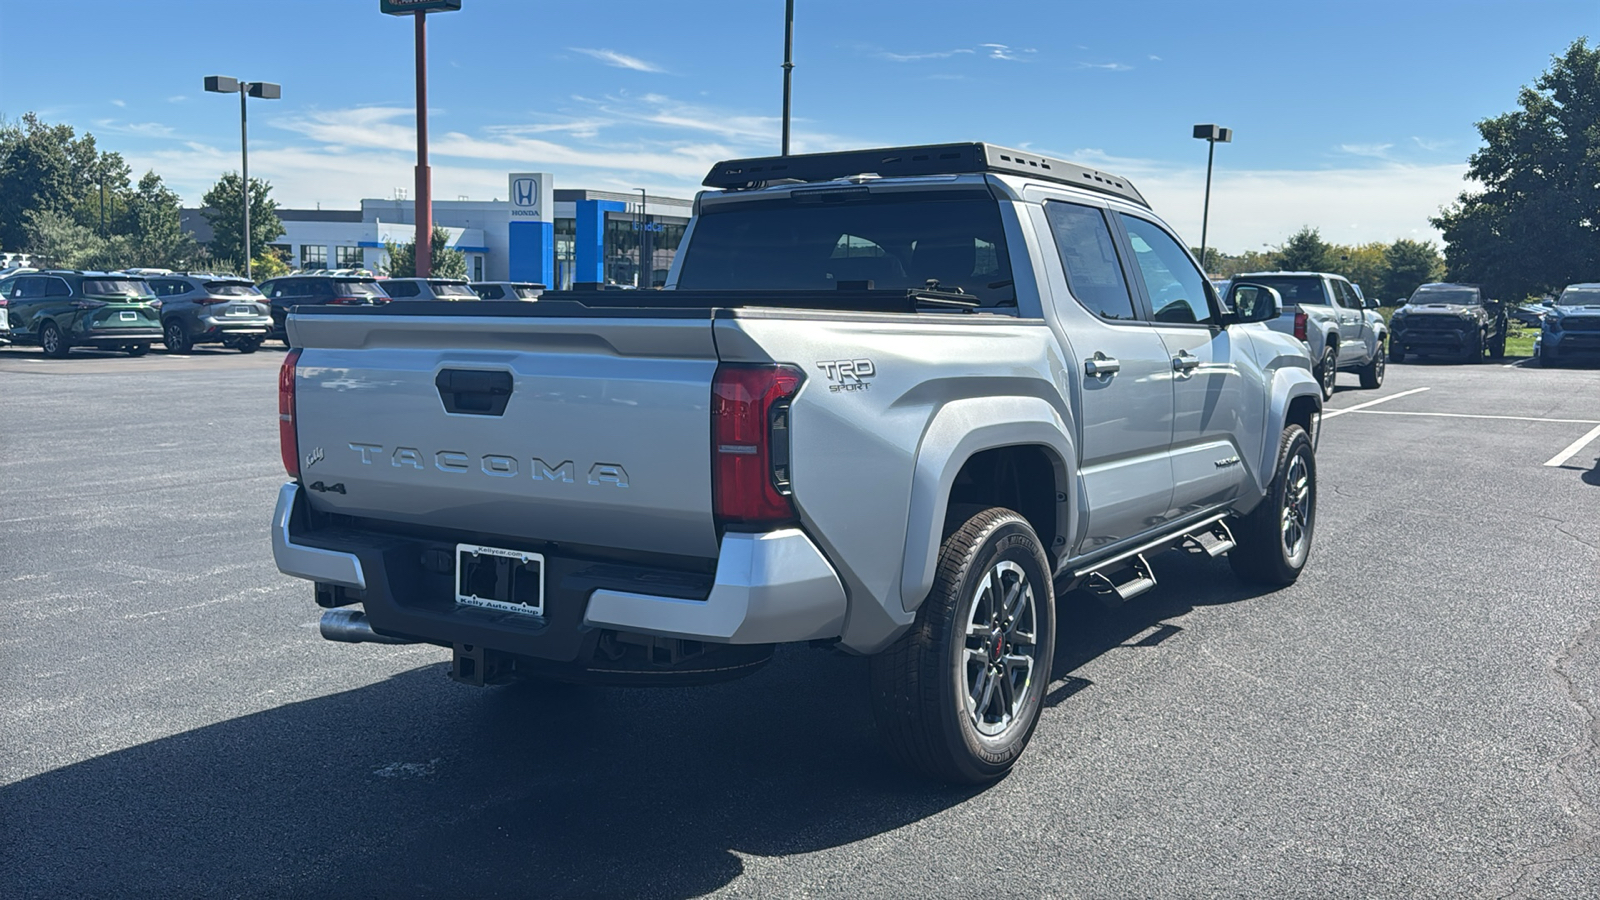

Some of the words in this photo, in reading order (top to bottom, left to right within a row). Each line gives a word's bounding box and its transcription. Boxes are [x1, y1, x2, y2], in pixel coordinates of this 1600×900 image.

[816, 358, 876, 384] TRD
[829, 382, 872, 393] SPORT
[349, 442, 629, 488] TACOMA
[478, 547, 523, 557] Kellycar.com
[460, 598, 484, 607] Kelly
[486, 602, 508, 610] Auto
[510, 606, 539, 615] Group
[979, 746, 1010, 763] MICHELIN
